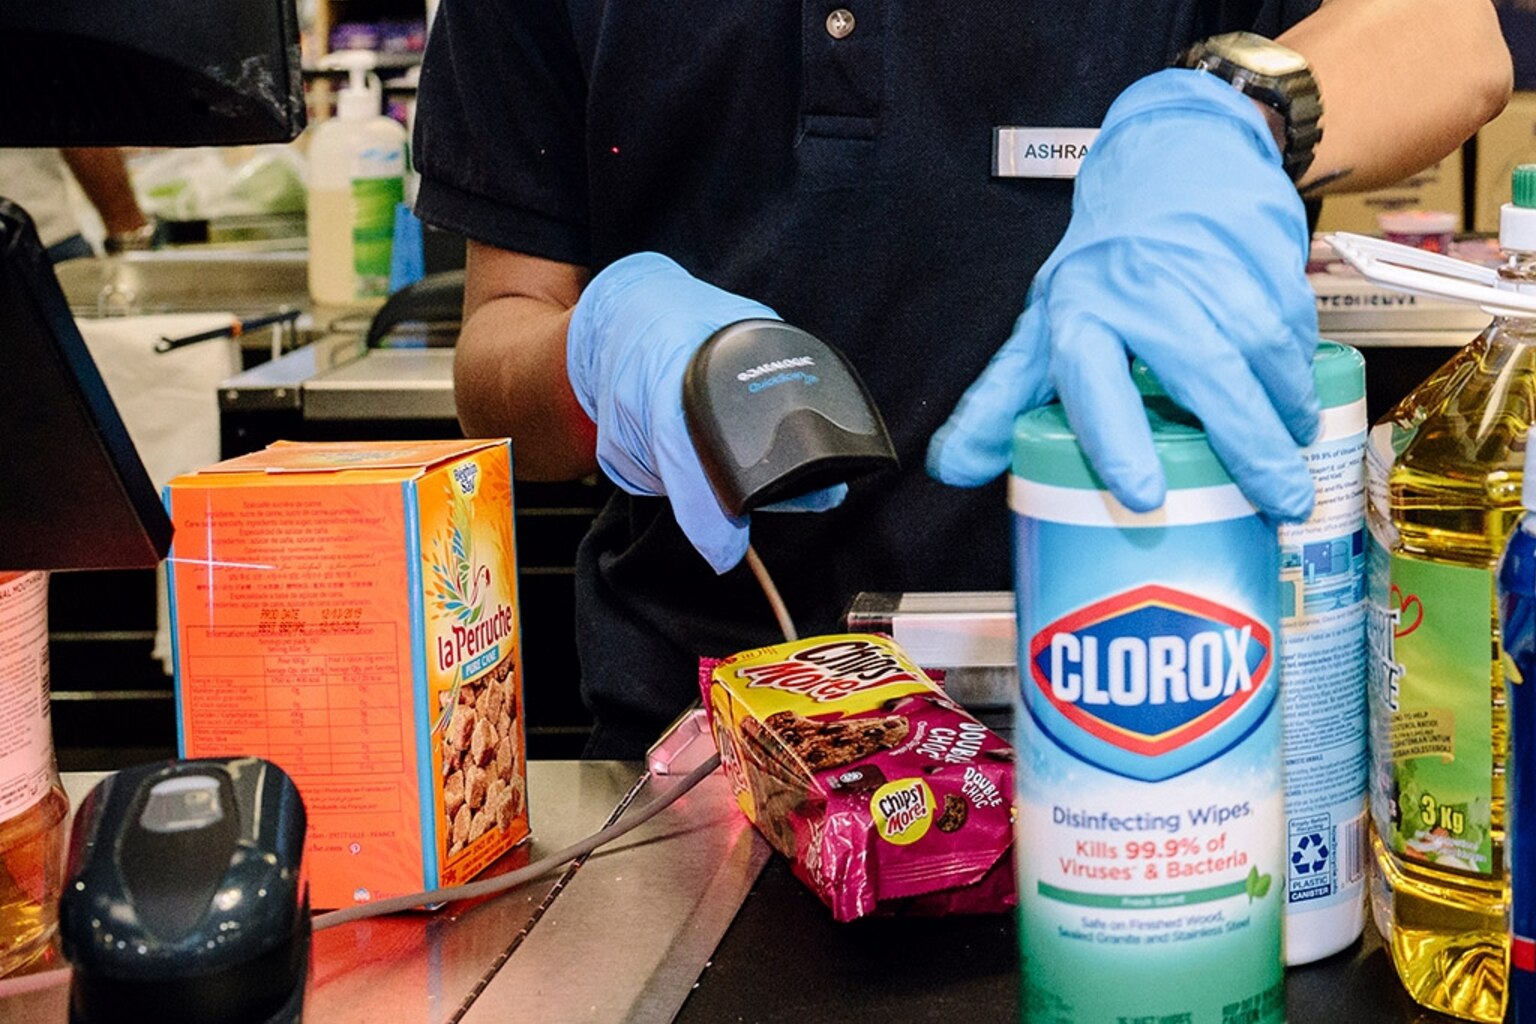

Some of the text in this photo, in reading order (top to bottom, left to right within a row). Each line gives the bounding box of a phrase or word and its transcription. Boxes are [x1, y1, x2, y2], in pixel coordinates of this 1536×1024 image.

[437, 604, 512, 671] la Perruche
[788, 640, 905, 680] Chips
[1051, 625, 1253, 706] CLOROX
[878, 783, 919, 819] Chips
[961, 779, 989, 809] CHOC
[964, 766, 1003, 808] DOUBLE
[1053, 801, 1250, 833] Disinfecting Wipes
[1421, 794, 1465, 835] 3 Kg
[1076, 831, 1227, 859] Kills 99.9% of
[1144, 864, 1158, 880] &
[1166, 850, 1248, 879] Bacteria
[1292, 887, 1329, 901] CANISTER
[1293, 876, 1328, 889] PLASTIC
